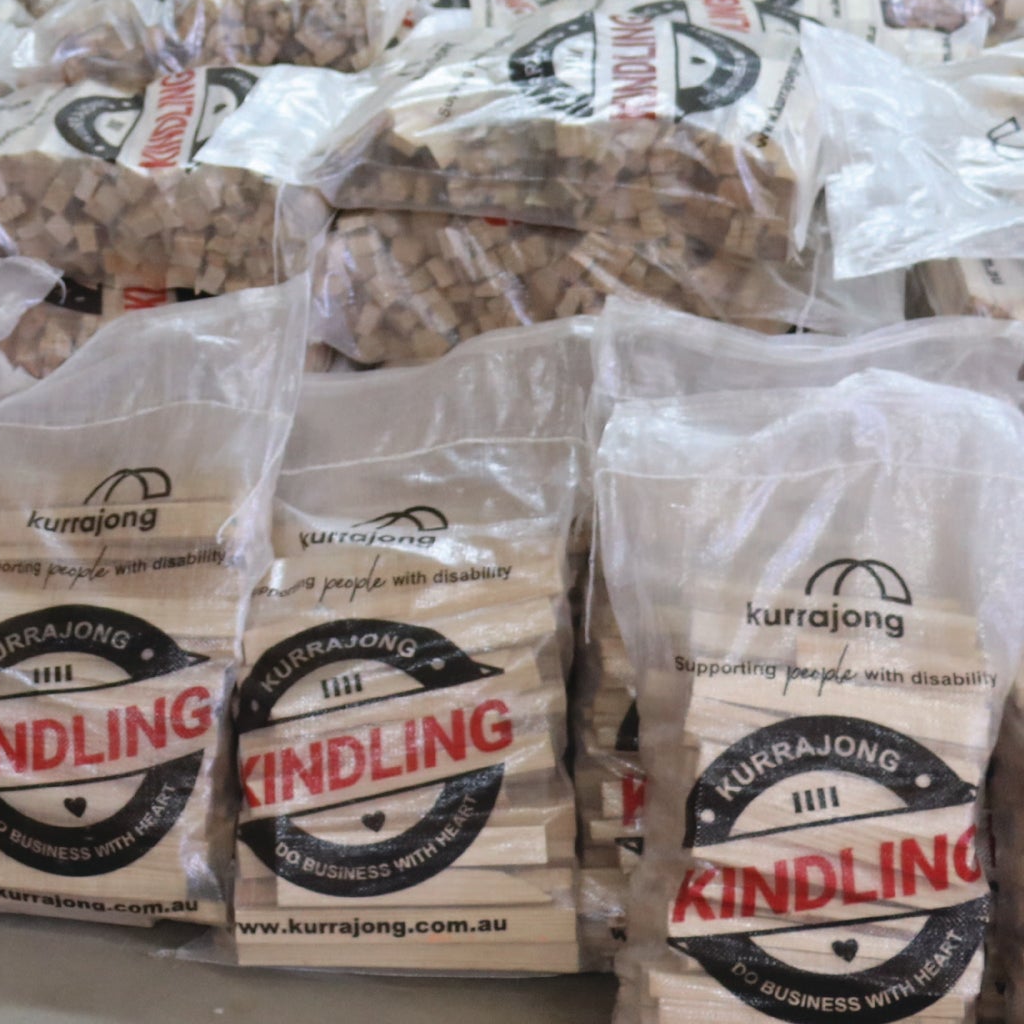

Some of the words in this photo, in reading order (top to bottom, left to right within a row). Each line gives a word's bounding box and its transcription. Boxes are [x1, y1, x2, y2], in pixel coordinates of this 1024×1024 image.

[27, 507, 159, 536] kurrajong
[299, 530, 436, 551] kurrajong
[42, 545, 109, 590] people
[114, 558, 147, 576] with
[152, 548, 226, 572] disability
[318, 554, 387, 603] people
[392, 570, 427, 587] with
[433, 564, 513, 587] disability
[746, 601, 905, 638] kurrajong
[260, 632, 419, 694] KURRAJONG
[674, 656, 777, 679] Supporting
[782, 642, 857, 697] people
[865, 668, 904, 685] with
[911, 670, 998, 689] disability
[240, 698, 515, 809] KINDLING
[714, 734, 902, 802] KURRAJONG
[9, 827, 92, 862] BUSINESS
[93, 833, 136, 858] WITH
[134, 781, 177, 837] HEART
[275, 842, 301, 866] DO
[302, 857, 392, 881] BUSINESS
[392, 841, 438, 873] WITH
[435, 793, 480, 849] HEART
[235, 916, 508, 938] ww.kurrajong.com.au
[730, 961, 759, 986] DO
[760, 979, 863, 1013] BUSINESS
[864, 979, 917, 1011] WITH
[913, 928, 965, 989] HEART
